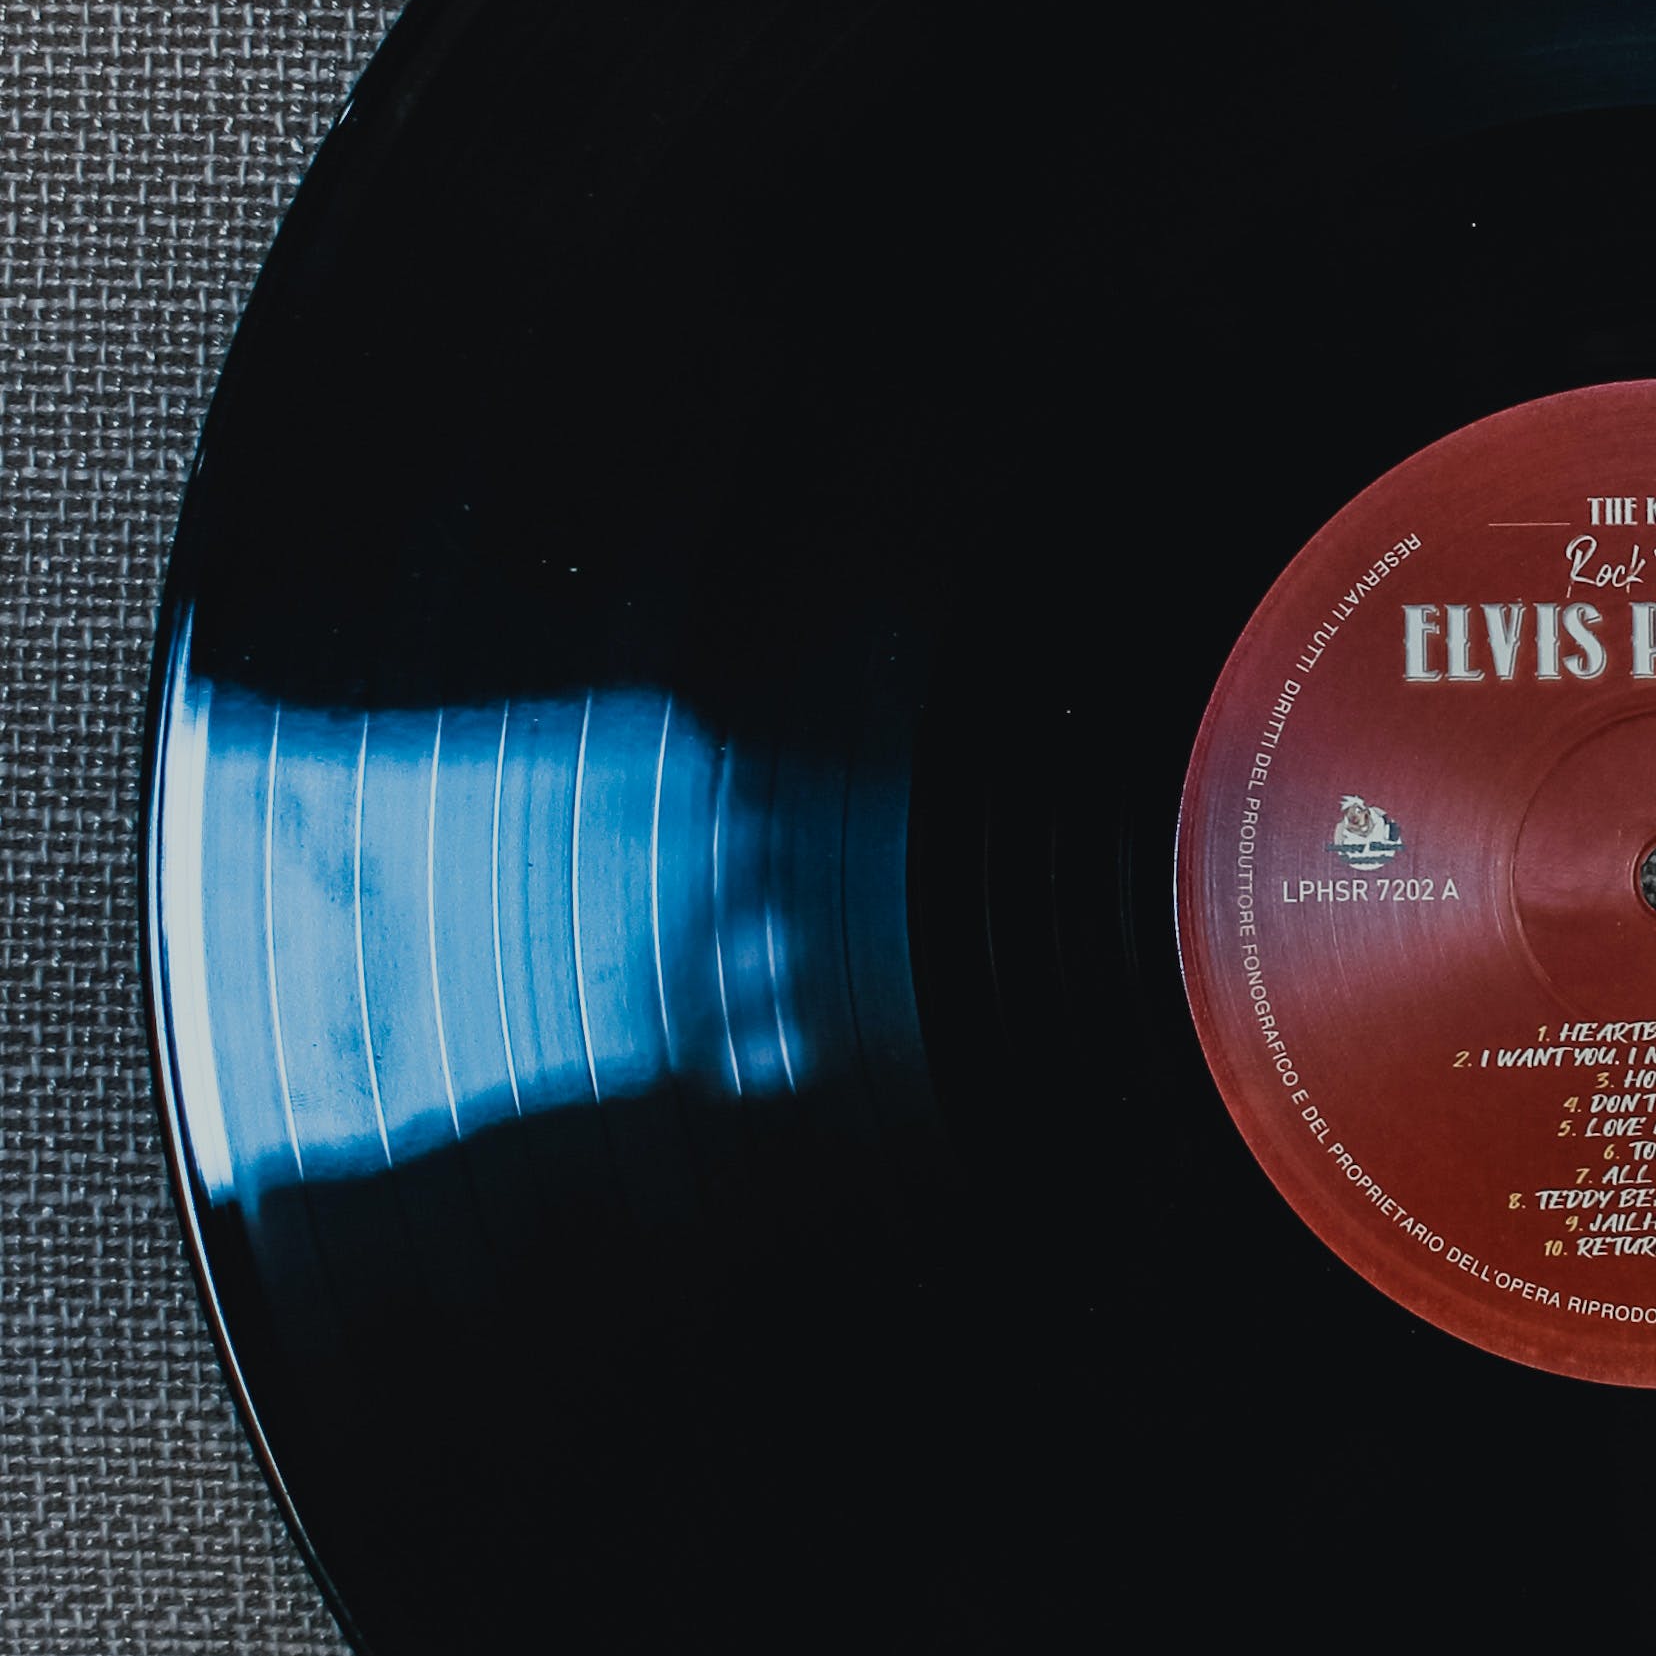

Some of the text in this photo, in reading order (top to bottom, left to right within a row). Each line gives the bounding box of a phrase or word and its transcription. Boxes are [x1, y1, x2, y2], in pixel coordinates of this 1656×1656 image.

[1587, 496, 1639, 526] THE
[1331, 533, 1421, 621] RESERVATI
[1565, 534, 1646, 599] Rock
[1296, 622, 1339, 673] TUTTI
[1402, 601, 1606, 682] ELVIS
[1261, 679, 1301, 749] DIRITTI
[1248, 752, 1272, 790] DEL
[1237, 796, 1261, 937] PRODUTTORE
[1283, 878, 1460, 903] LPHSR 7202 A
[1241, 943, 1299, 1087] FONOGRAFICO
[1538, 1026, 1549, 1041] 1.
[1454, 1051, 1471, 1067] 2.
[1481, 1049, 1489, 1067] I
[1497, 1048, 1571, 1067] WANT
[1628, 1047, 1635, 1064] I
[1596, 1072, 1614, 1087] 3.
[1291, 1089, 1309, 1105] E
[1563, 1097, 1581, 1112] 4.
[1301, 1105, 1331, 1144] DEL
[1558, 1121, 1576, 1136] 5.
[1584, 1117, 1643, 1137] LOVE
[1604, 1145, 1620, 1160] 6.
[1576, 1168, 1592, 1184] 7.
[1601, 1165, 1653, 1185] ALL
[1327, 1142, 1444, 1253] PROPRIETARIO
[1508, 1193, 1525, 1208] 8.
[1535, 1190, 1609, 1210] TEDDY
[1565, 1217, 1582, 1232] 9.
[1544, 1240, 1566, 1256] 10.
[1446, 1246, 1561, 1309] DELL'OPERA
